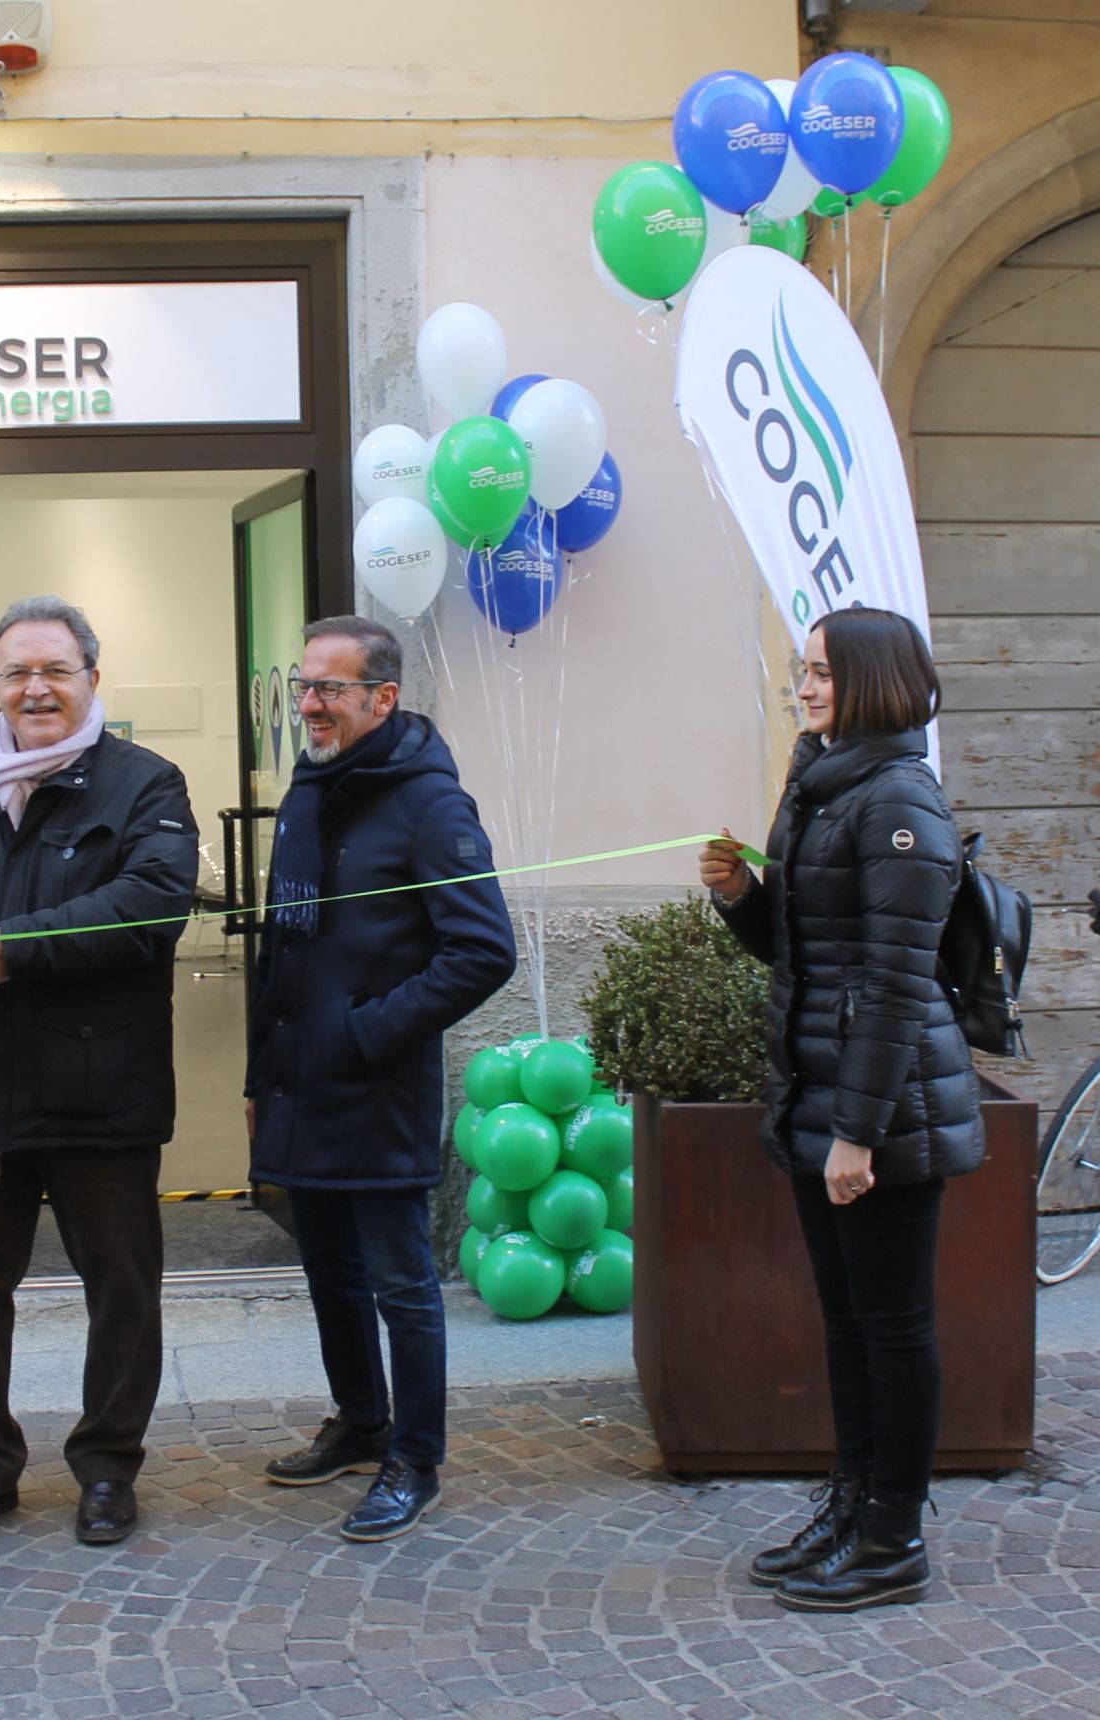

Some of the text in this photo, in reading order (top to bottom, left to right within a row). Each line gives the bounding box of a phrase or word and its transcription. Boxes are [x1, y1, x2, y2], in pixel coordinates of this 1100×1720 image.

[801, 116, 876, 134] COGESER
[833, 130, 876, 140] energia
[372, 465, 422, 480] COGESER
[469, 471, 525, 488] COGESER
[726, 348, 864, 610] COGE
[366, 550, 432, 569] COGESER
[497, 560, 555, 574] COGESER
